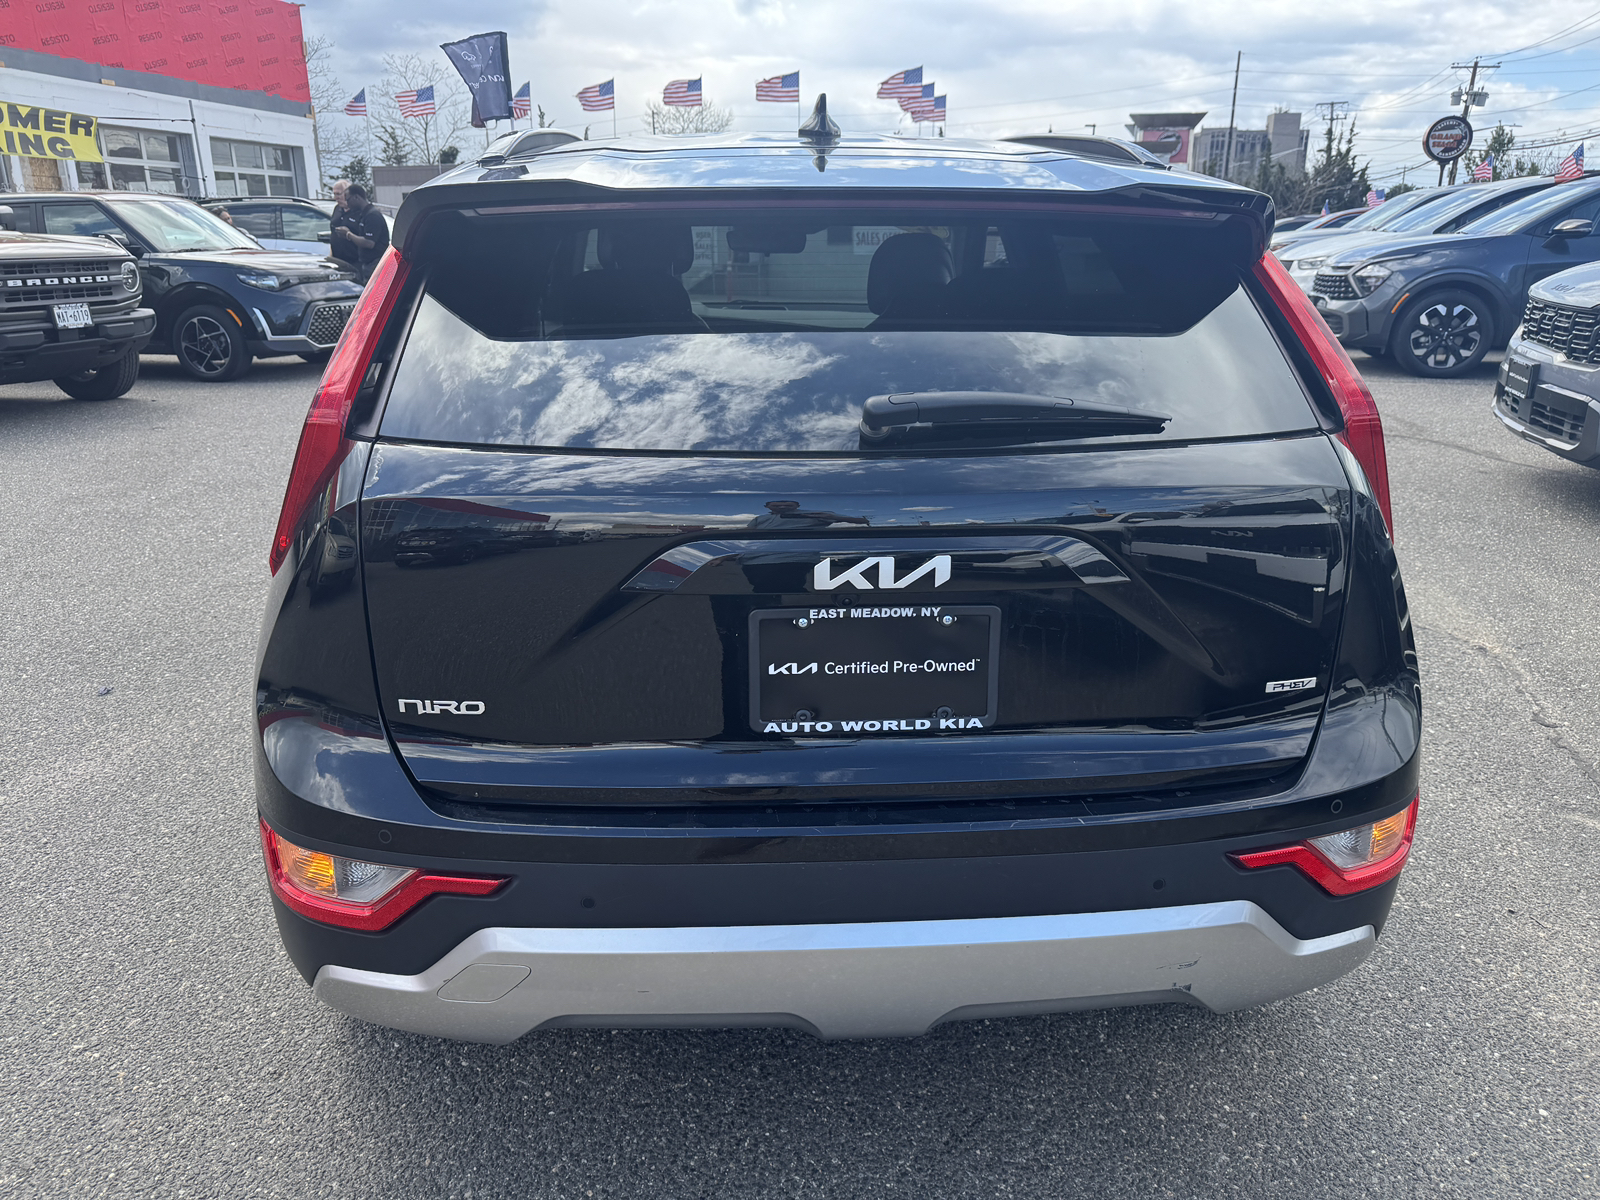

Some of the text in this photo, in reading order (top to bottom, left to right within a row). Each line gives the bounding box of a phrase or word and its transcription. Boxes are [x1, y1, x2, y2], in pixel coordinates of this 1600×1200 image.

[41, 34, 70, 46] RESISTO
[92, 33, 119, 46] RESISTO
[138, 31, 163, 43] RESISTO
[181, 32, 204, 43] RESISTO
[221, 32, 241, 42] RESISTO
[257, 33, 276, 43] RESISTO
[7, 275, 108, 287] BRONCO
[814, 555, 952, 590] KIA
[809, 609, 846, 619] EAST
[921, 607, 941, 617] NY
[768, 662, 818, 675] KIA
[824, 661, 888, 674] Certified
[1273, 679, 1312, 690] PHEV
[398, 699, 486, 715] NIRO
[763, 717, 984, 733] AUTO WORLD KIA
